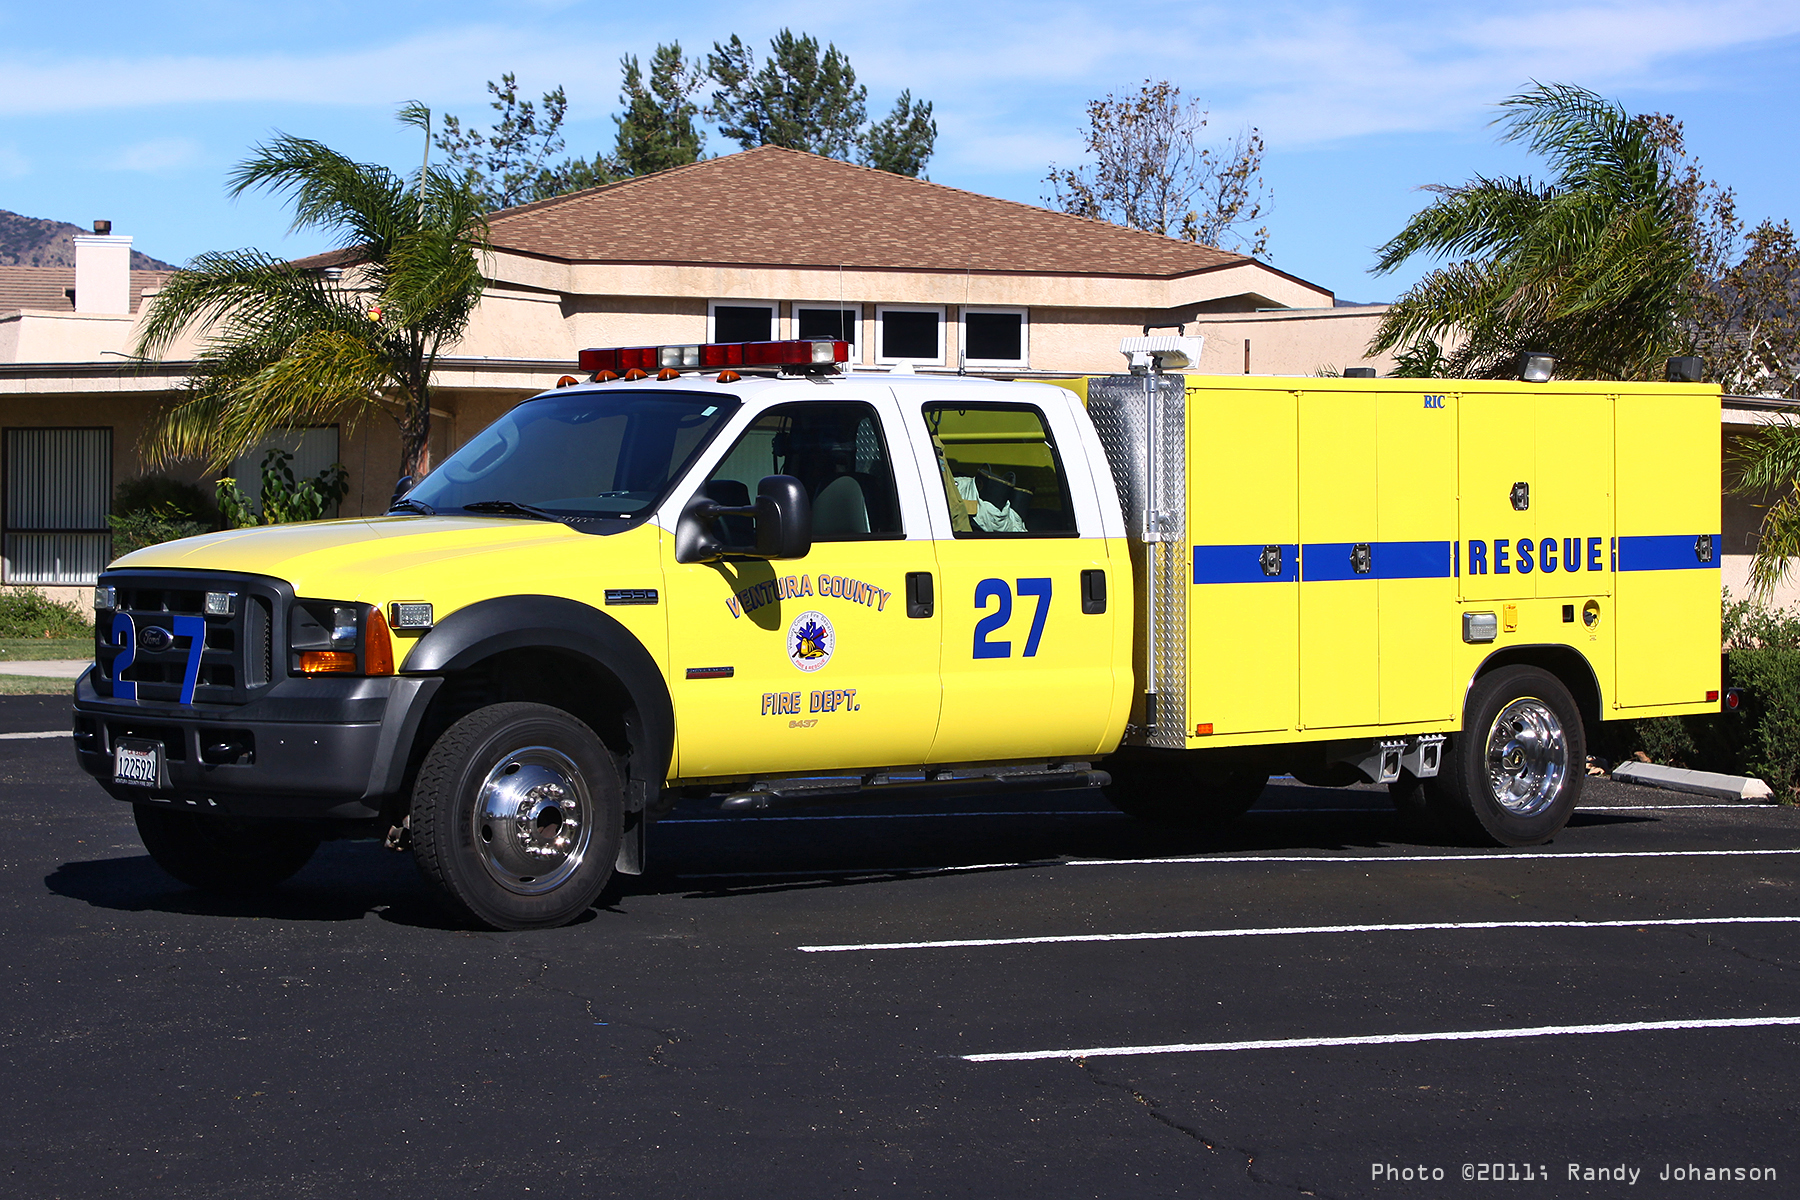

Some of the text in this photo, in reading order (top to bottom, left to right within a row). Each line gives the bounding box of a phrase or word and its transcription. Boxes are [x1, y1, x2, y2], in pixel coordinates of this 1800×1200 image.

[1423, 394, 1446, 409] RIC
[1468, 537, 1603, 576] RESCUE
[726, 574, 892, 619] VENTURA COUNTY
[973, 577, 1052, 659] 27
[143, 630, 162, 645] Ford
[761, 689, 860, 715] FIRE DEPT.
